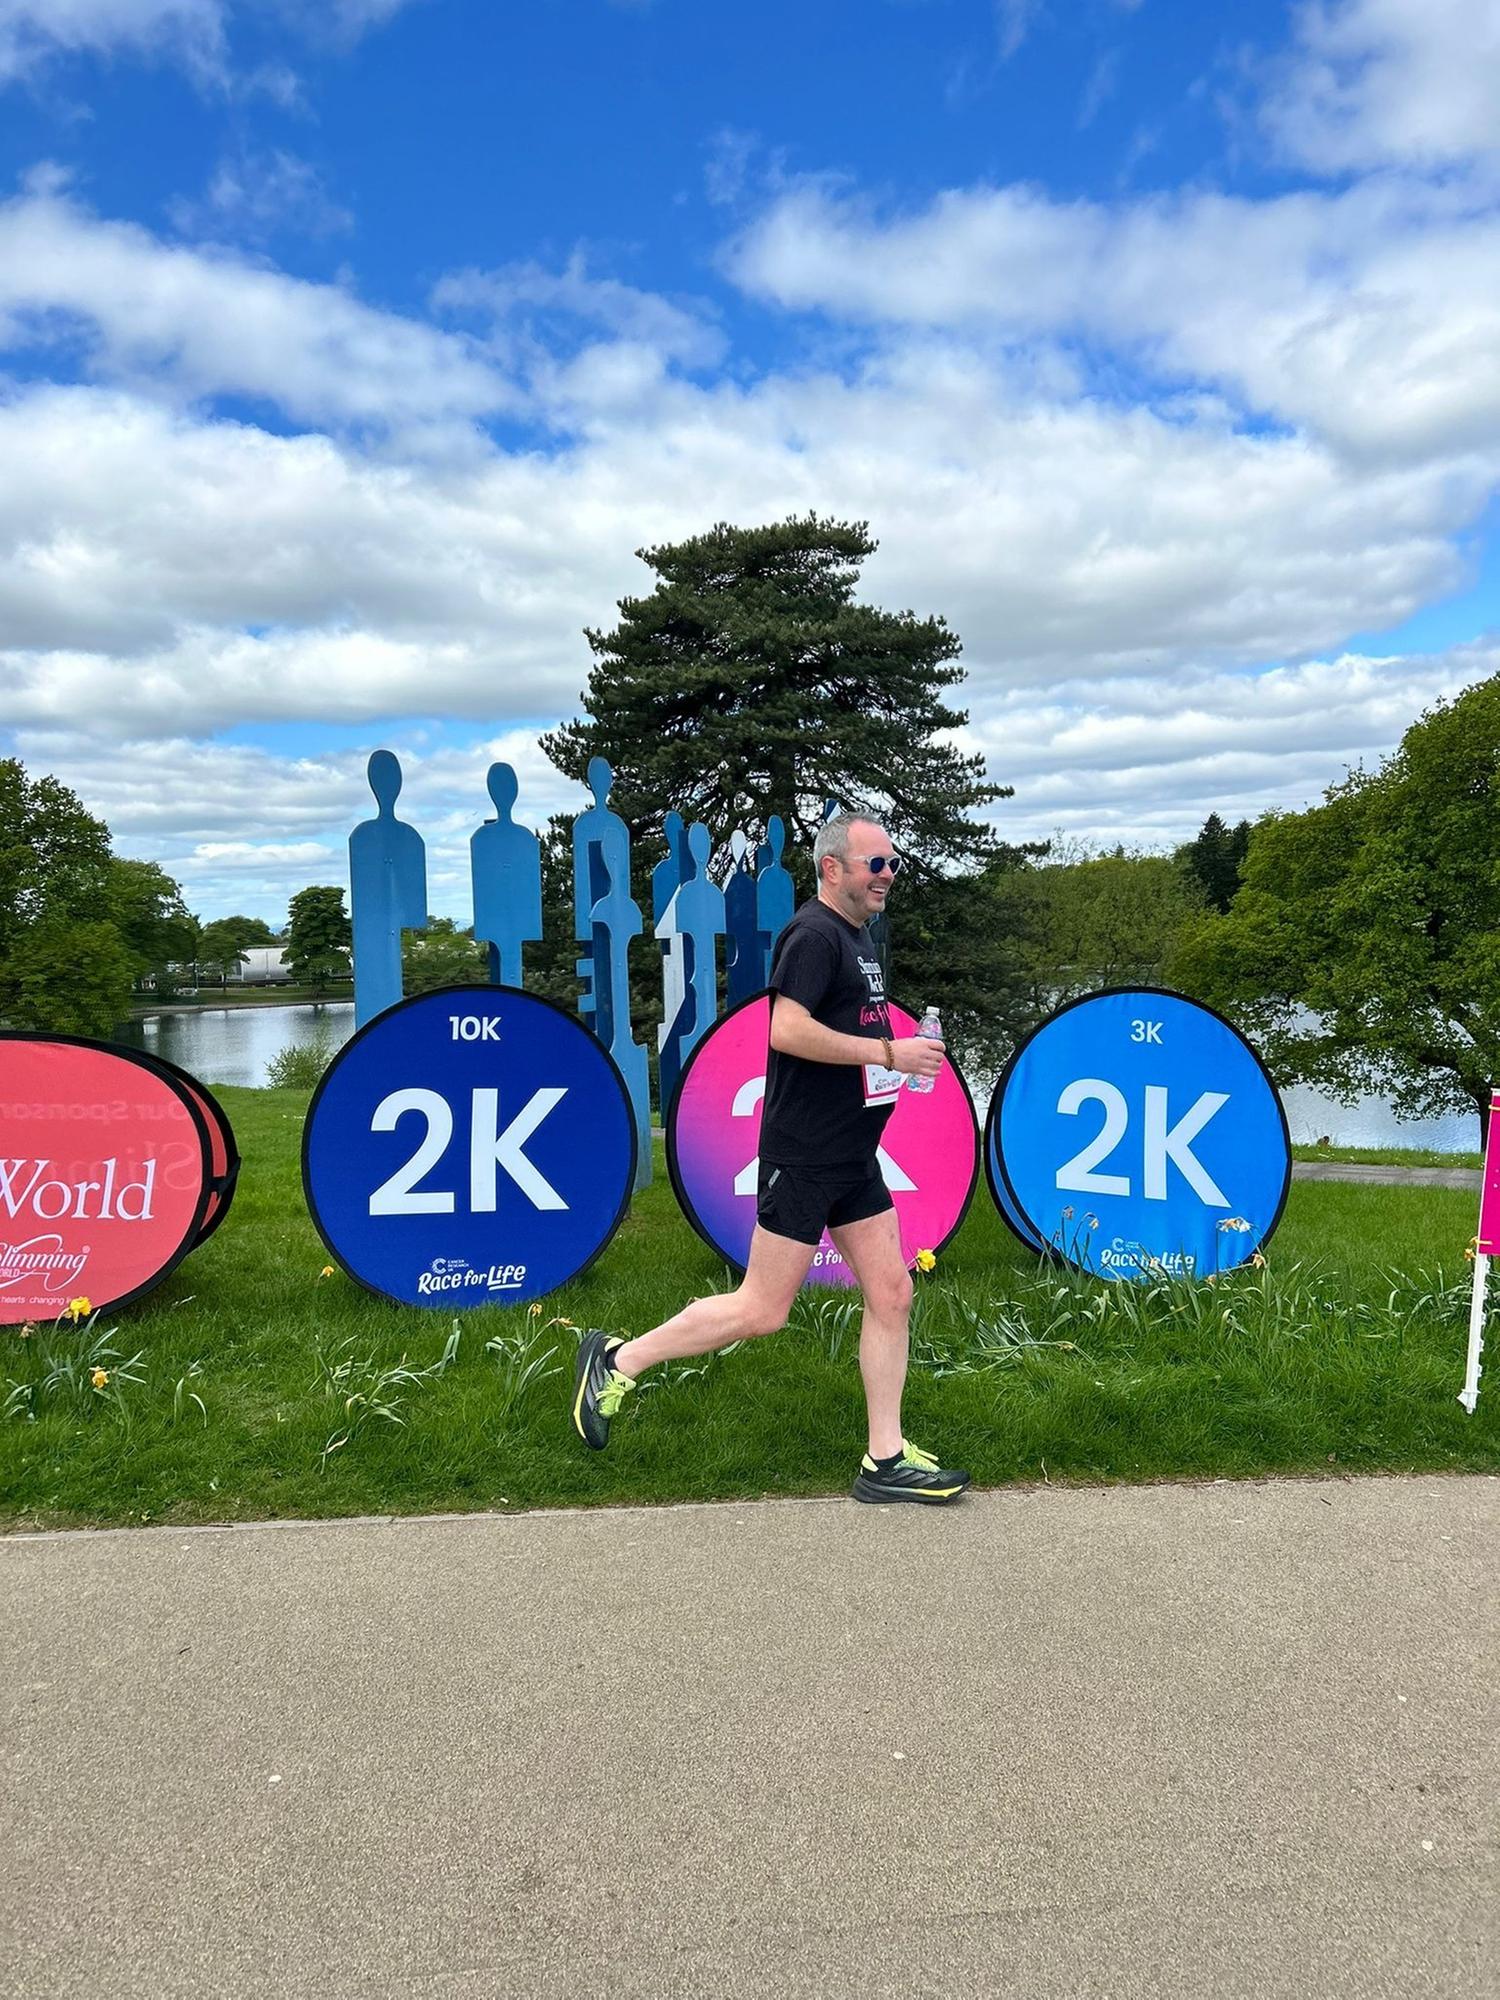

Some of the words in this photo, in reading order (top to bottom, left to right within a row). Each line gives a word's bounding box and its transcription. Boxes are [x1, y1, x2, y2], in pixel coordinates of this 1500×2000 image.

[449, 1016, 502, 1041] 10K
[1130, 1020, 1164, 1044] 3K
[369, 1087, 570, 1216] 2K
[1056, 1078, 1232, 1209] 2K
[0, 1157, 157, 1220] World
[1161, 1251, 1195, 1269] Life
[418, 1272, 462, 1295] Race
[464, 1270, 487, 1287] for
[487, 1265, 526, 1286] Life
[29, 1296, 65, 1306] changing
